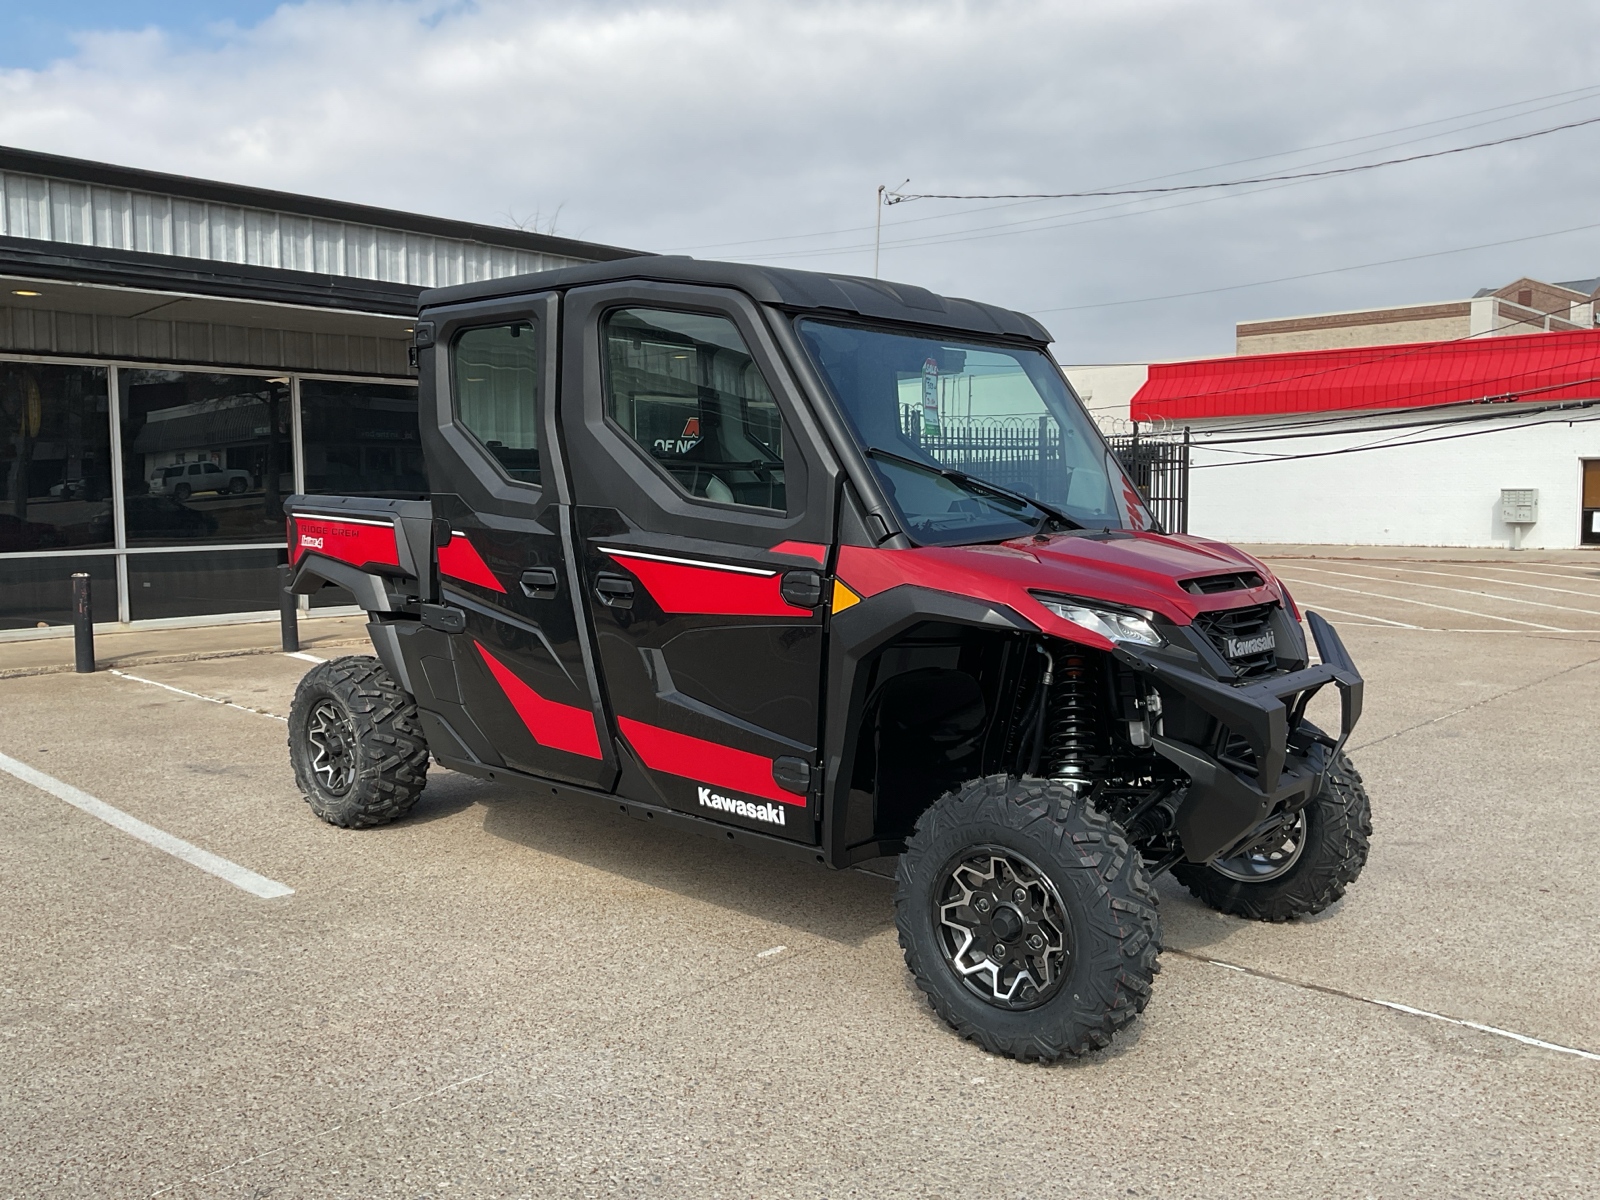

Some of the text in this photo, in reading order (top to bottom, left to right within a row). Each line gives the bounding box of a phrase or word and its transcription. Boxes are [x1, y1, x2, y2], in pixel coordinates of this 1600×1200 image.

[301, 525, 359, 538] RIDGE CREW
[1228, 631, 1275, 657] Kawasaki
[697, 786, 786, 826] Kawasaki
